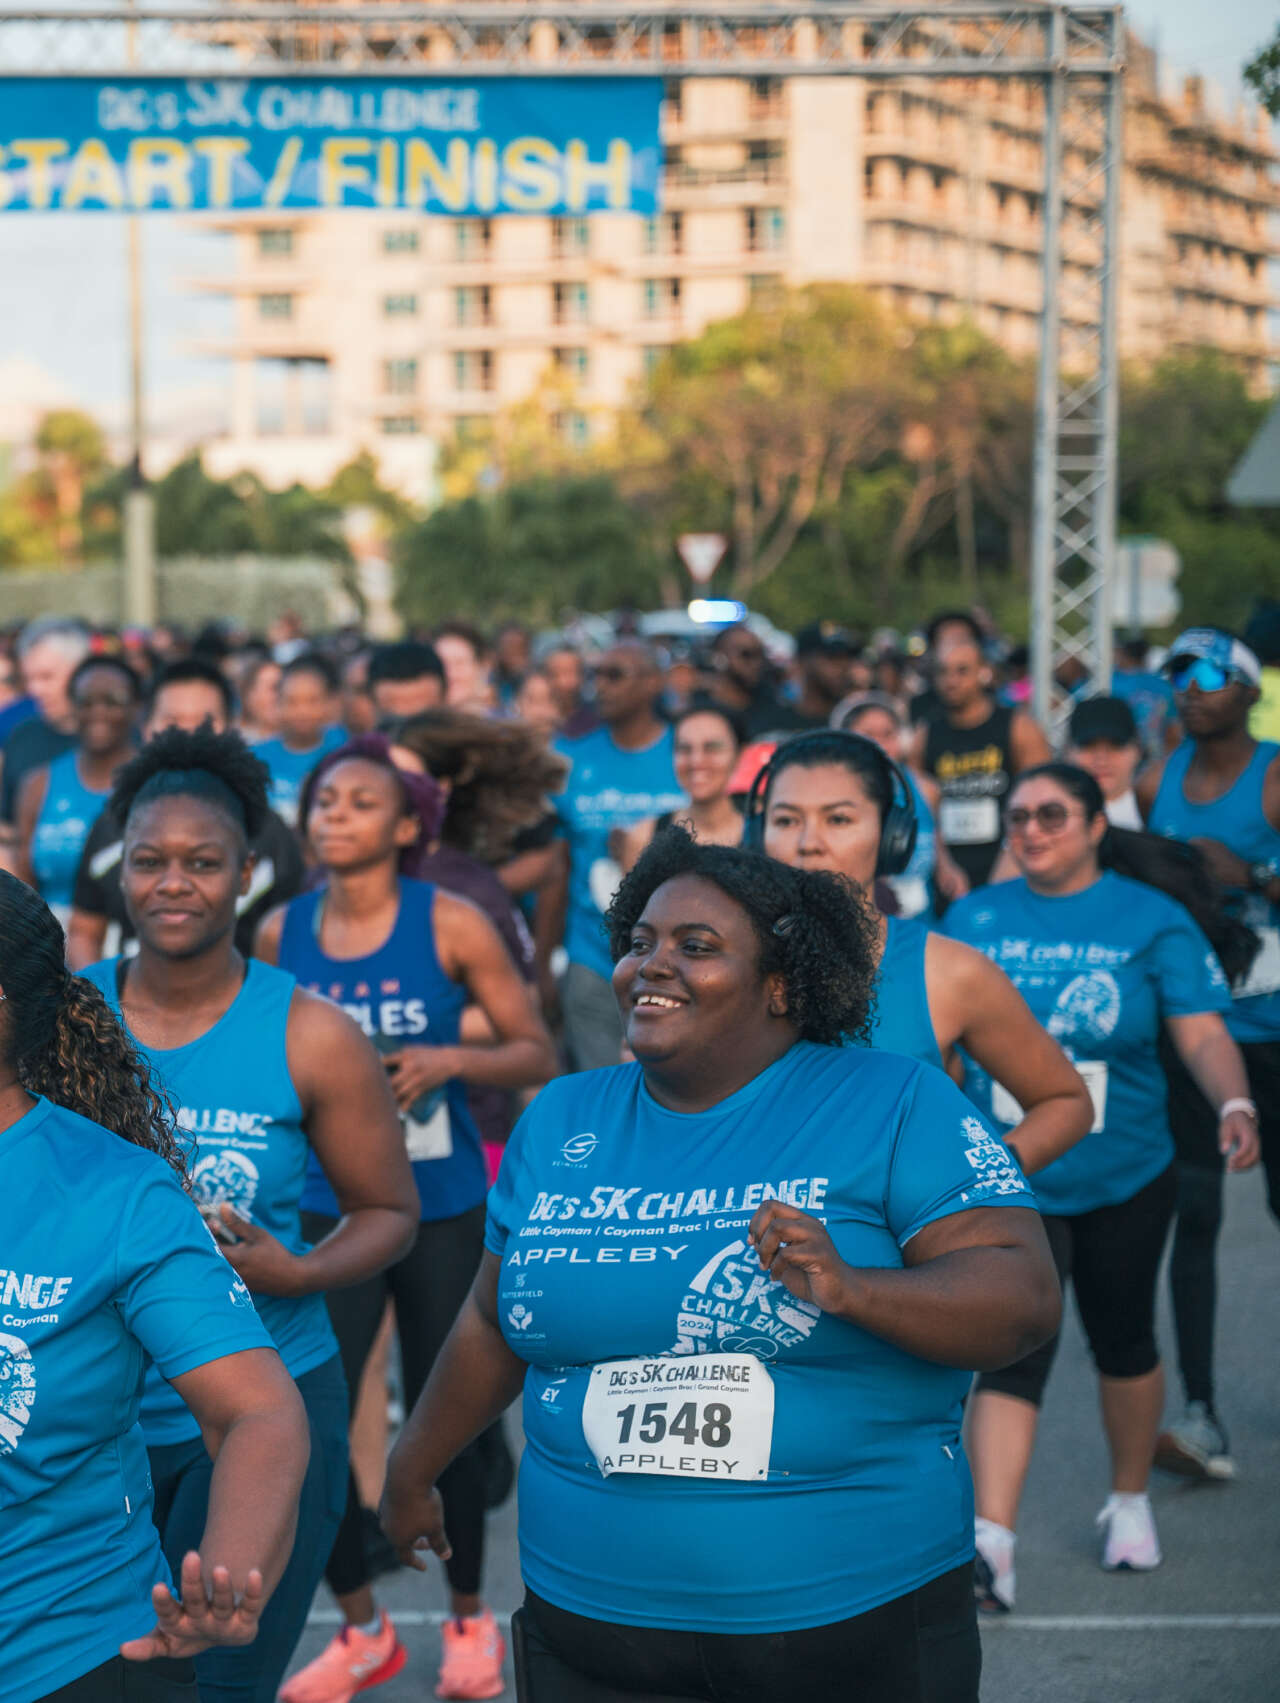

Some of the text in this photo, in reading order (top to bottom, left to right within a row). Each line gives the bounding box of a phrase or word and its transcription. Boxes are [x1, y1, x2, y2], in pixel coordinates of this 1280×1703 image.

[258, 86, 480, 132] CHALLENGE
[321, 137, 632, 212] FINISH
[580, 1186, 642, 1220] 5K
[637, 1177, 829, 1221] CHALLENGE
[519, 1219, 751, 1237] Little Cayman Cayman Brac Gran
[507, 1244, 689, 1266] APPLEBY
[712, 1261, 783, 1315] 5K
[3, 1312, 59, 1329] Cayman
[679, 1320, 712, 1331] 2024
[681, 1295, 804, 1348] CHALLENGE
[641, 1364, 666, 1383] 5K
[666, 1365, 751, 1383] CHALLENGE
[541, 1387, 560, 1403] EY
[616, 1402, 732, 1448] 1548
[603, 1454, 740, 1474] APPLEBY
